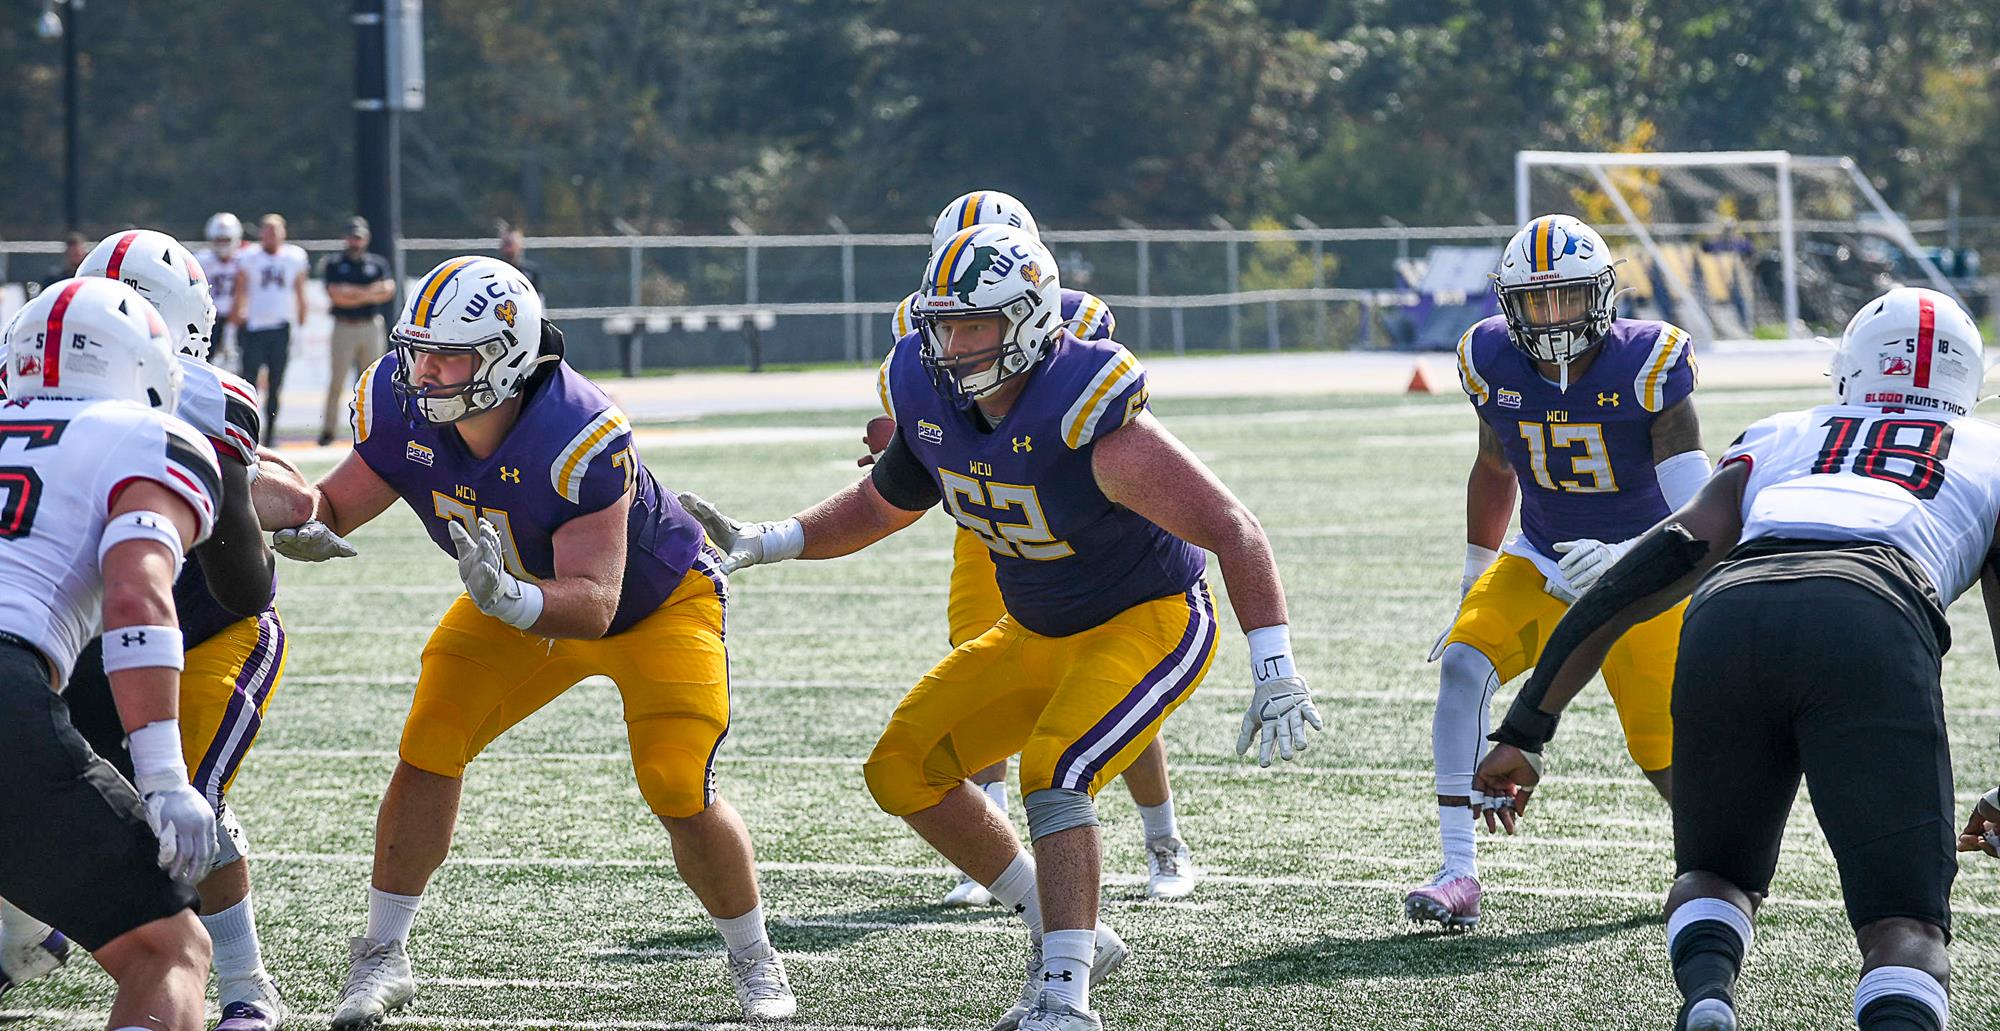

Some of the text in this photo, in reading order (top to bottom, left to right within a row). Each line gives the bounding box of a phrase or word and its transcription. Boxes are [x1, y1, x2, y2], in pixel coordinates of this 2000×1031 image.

[465, 279, 522, 318] WCU
[35, 333, 45, 349] 5
[72, 333, 86, 349] 15
[1906, 338, 1915, 353] 5
[1938, 339, 1949, 354] 18
[1500, 393, 1520, 403] PSAC
[1865, 392, 1968, 417] BLOOD RUNS THICK
[1546, 410, 1568, 422] WCU
[919, 425, 942, 438] PSAC
[408, 446, 432, 461] PSAC
[1518, 420, 1620, 493] 13
[1811, 416, 1955, 500] 18
[969, 460, 992, 477] WCU
[455, 484, 477, 501] WCU
[938, 467, 1077, 561] 62
[432, 490, 543, 581] 71
